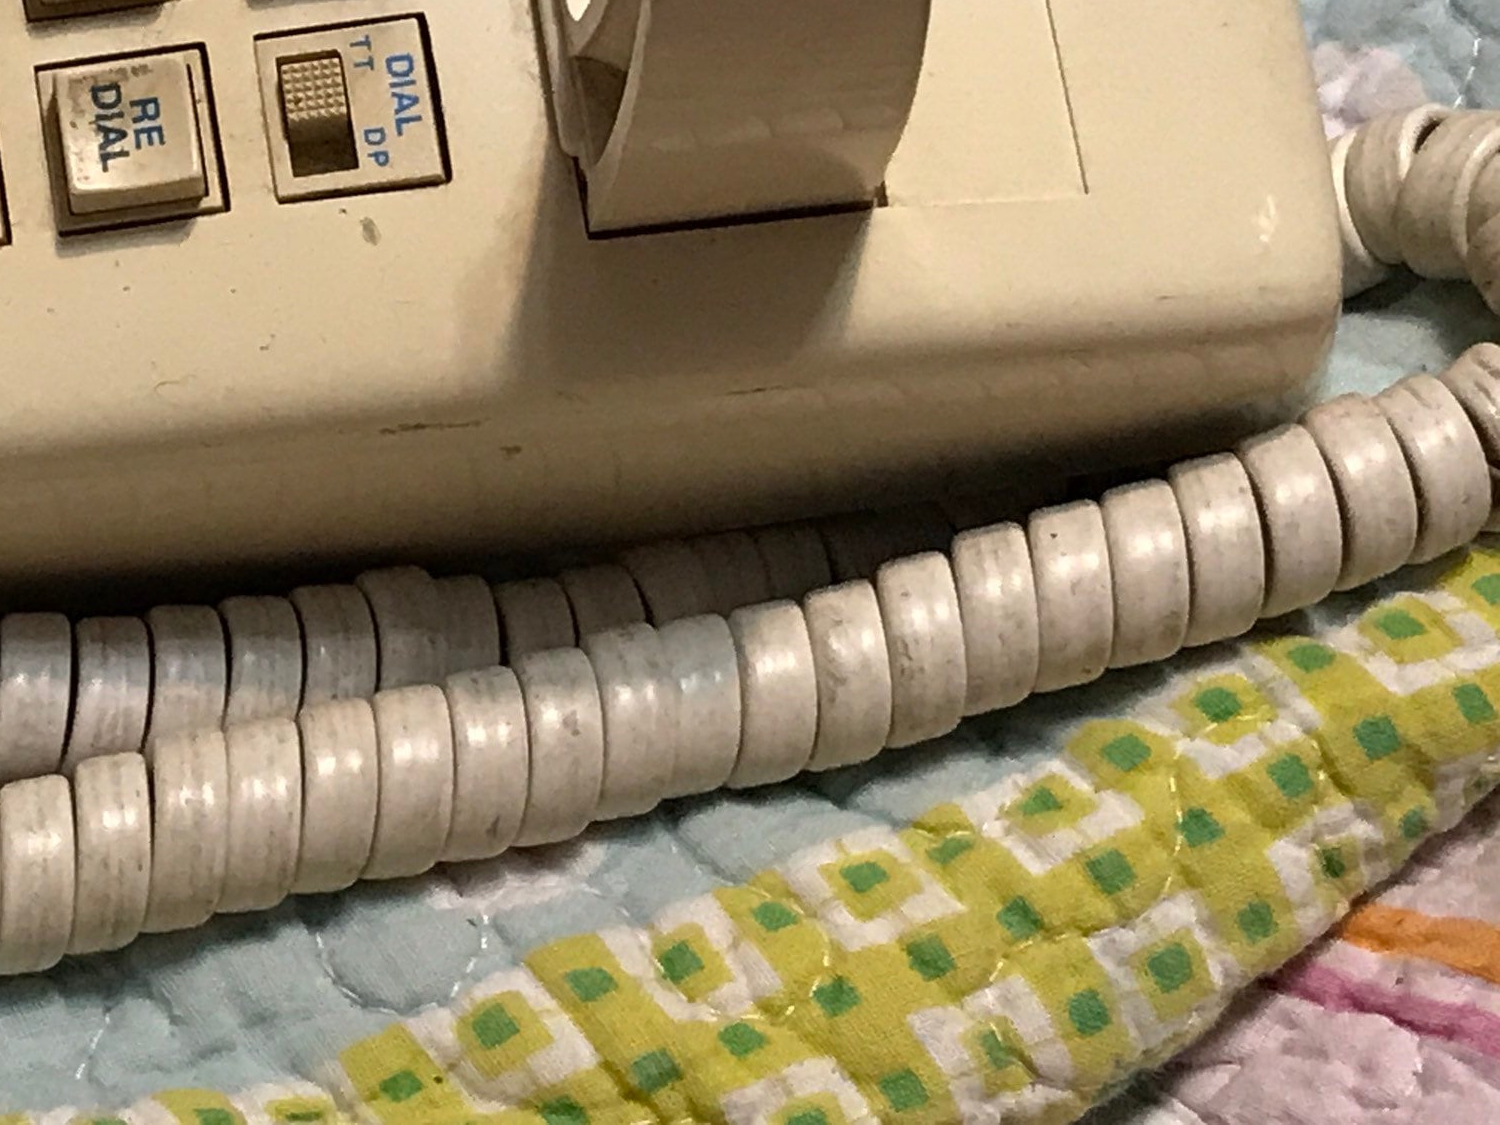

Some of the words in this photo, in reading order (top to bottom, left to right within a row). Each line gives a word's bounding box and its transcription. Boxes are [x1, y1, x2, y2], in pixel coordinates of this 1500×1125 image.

[88, 82, 131, 174] DIAL
[129, 95, 167, 150] RE
[348, 34, 375, 72] TT
[362, 127, 390, 168] DP
[384, 52, 424, 136] DIAL
